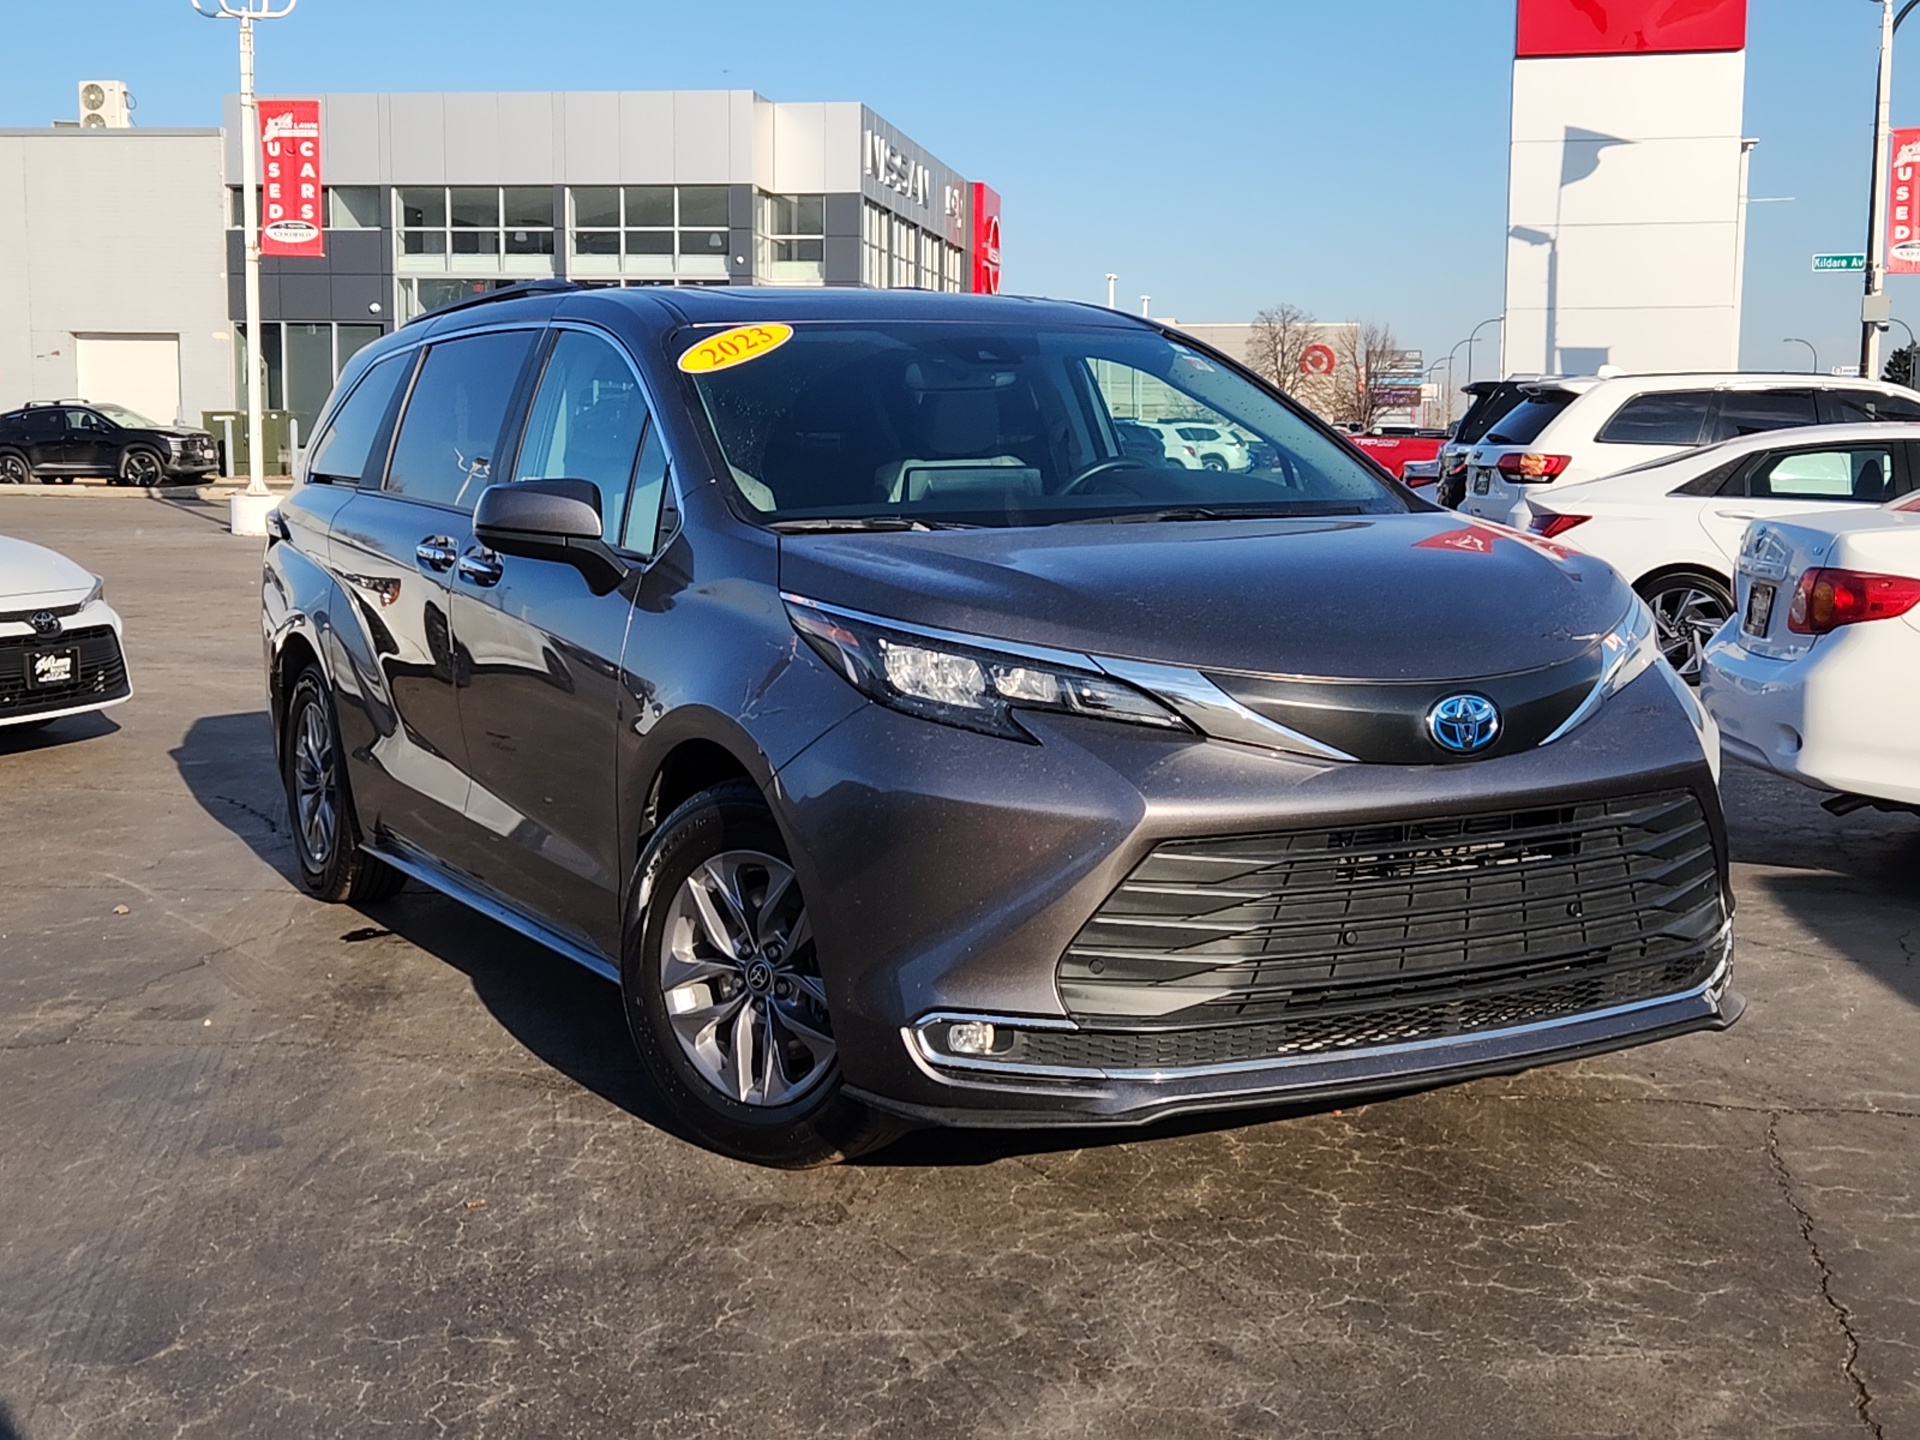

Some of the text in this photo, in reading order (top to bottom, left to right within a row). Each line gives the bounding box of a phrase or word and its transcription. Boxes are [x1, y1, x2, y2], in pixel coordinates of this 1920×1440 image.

[267, 141, 283, 219] USED
[299, 141, 316, 219] CARS
[863, 129, 929, 206] NISSAN
[1894, 166, 1912, 240] USED
[1815, 257, 1848, 268] Kildare
[700, 327, 773, 366] 2023
